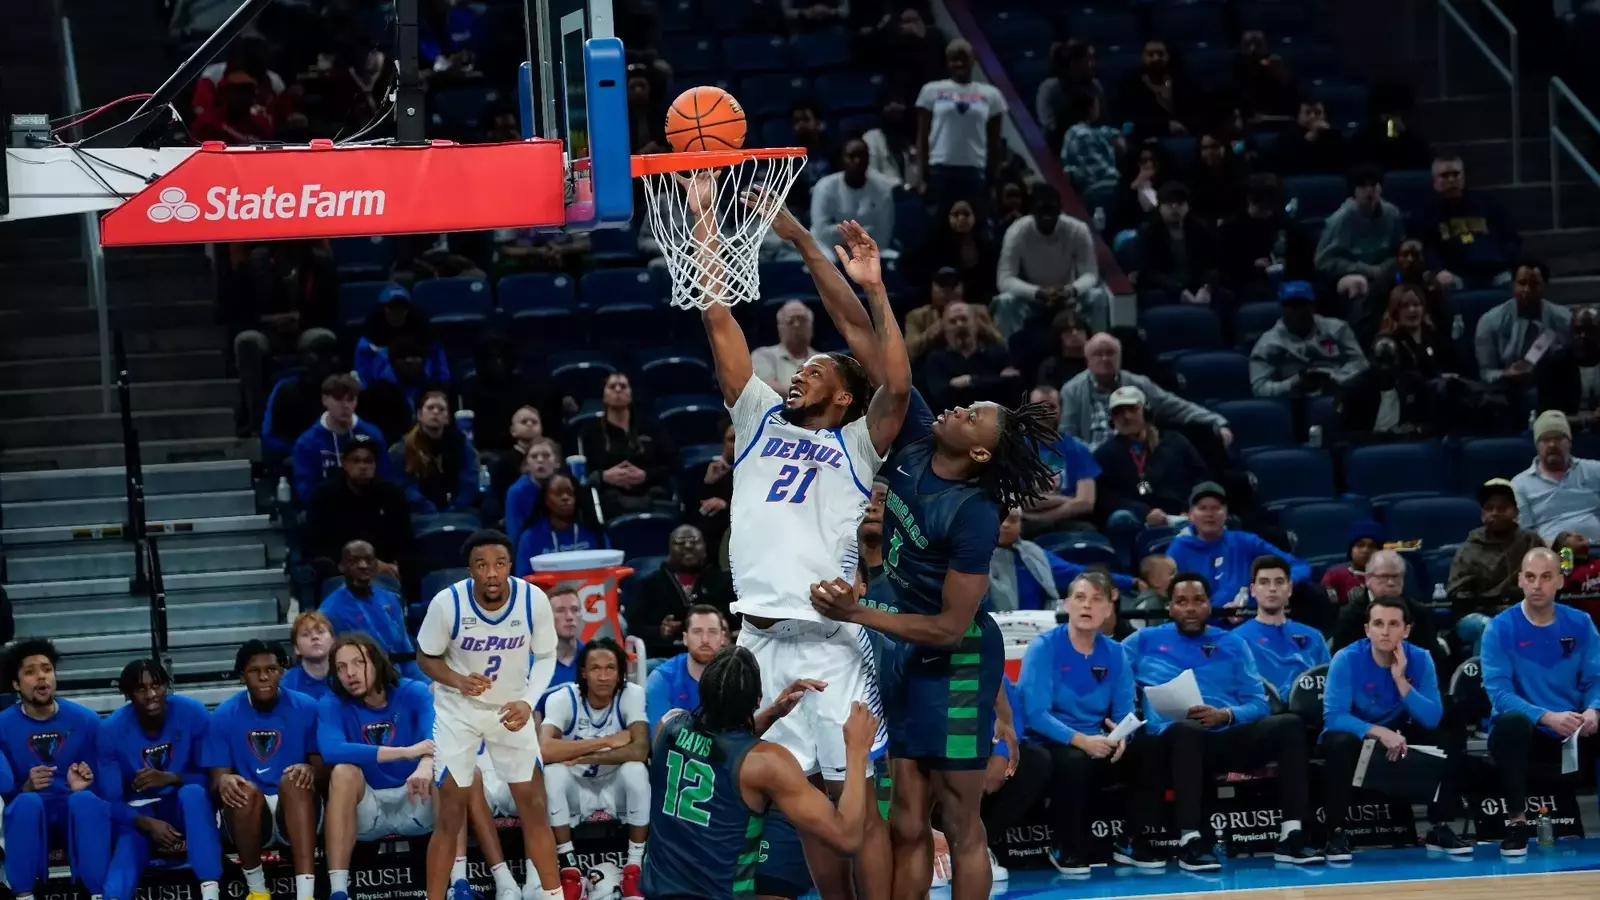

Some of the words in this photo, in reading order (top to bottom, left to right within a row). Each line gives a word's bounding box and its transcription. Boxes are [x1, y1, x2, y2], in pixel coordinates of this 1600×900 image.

[204, 185, 296, 221] State
[298, 184, 386, 218] Farm
[765, 464, 818, 504] 21
[484, 655, 502, 682] 2
[675, 728, 713, 758] DAVIS
[662, 750, 716, 828] 12
[1228, 809, 1283, 829] RUSH
[1232, 831, 1268, 842] Physical
[1008, 847, 1043, 857] Physical
[355, 867, 413, 888] RUSH
[356, 890, 392, 900] Physical
[393, 889, 428, 900] Therapy
